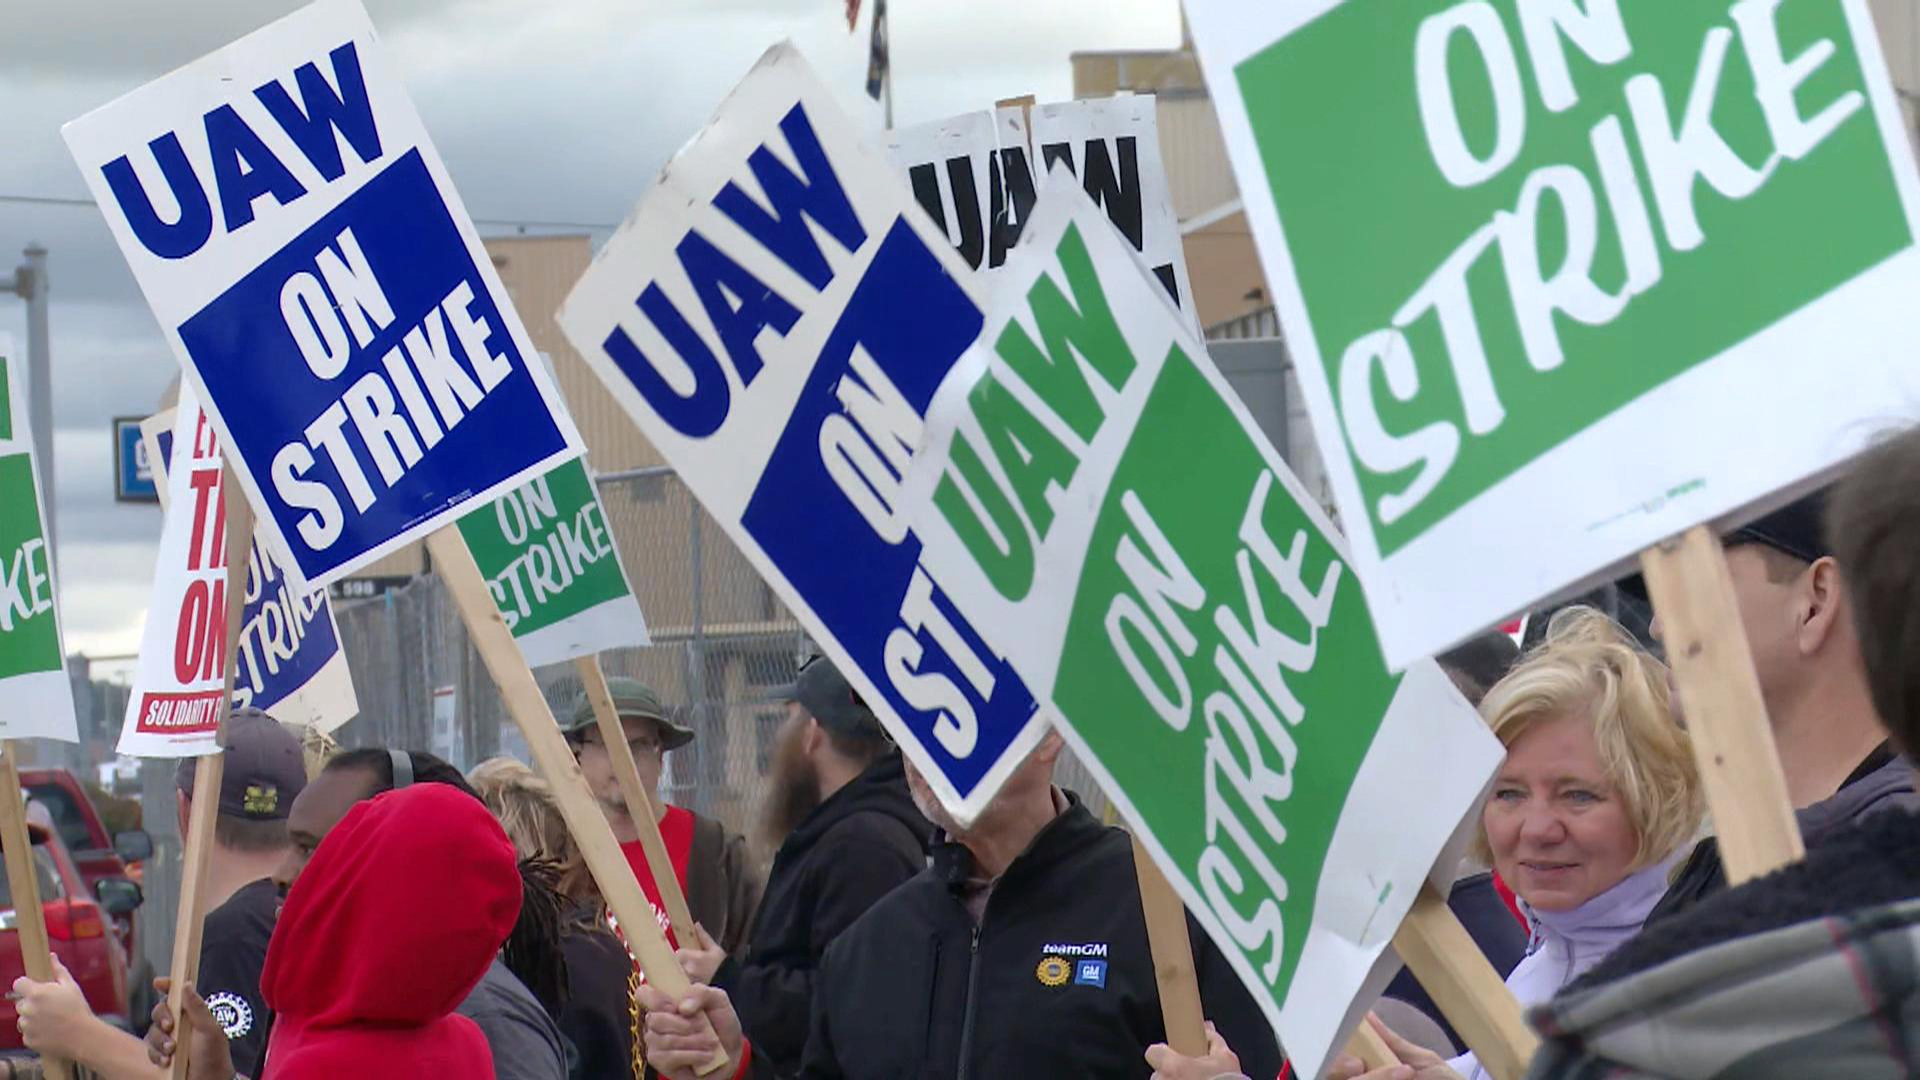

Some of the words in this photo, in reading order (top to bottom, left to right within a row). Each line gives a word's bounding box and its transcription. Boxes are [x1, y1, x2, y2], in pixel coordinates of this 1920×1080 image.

[101, 41, 383, 259] UAW
[1415, 0, 1632, 188] ON
[602, 101, 868, 438] UAW
[909, 137, 1143, 271] UAW
[1340, 0, 1864, 524] STRIKE
[280, 226, 396, 380] ON
[271, 280, 513, 551] STRIKE
[819, 341, 925, 545] ON
[932, 219, 1138, 603] UAW
[487, 501, 612, 630] STRIKE
[495, 475, 558, 546] ON
[1104, 490, 1206, 731] ON
[145, 699, 214, 726] SOLIDARITY
[1198, 469, 1342, 986] STRIKE
[212, 1007, 236, 1025] AW
[1042, 943, 1108, 957] teamGM
[1082, 965, 1100, 977] GM
